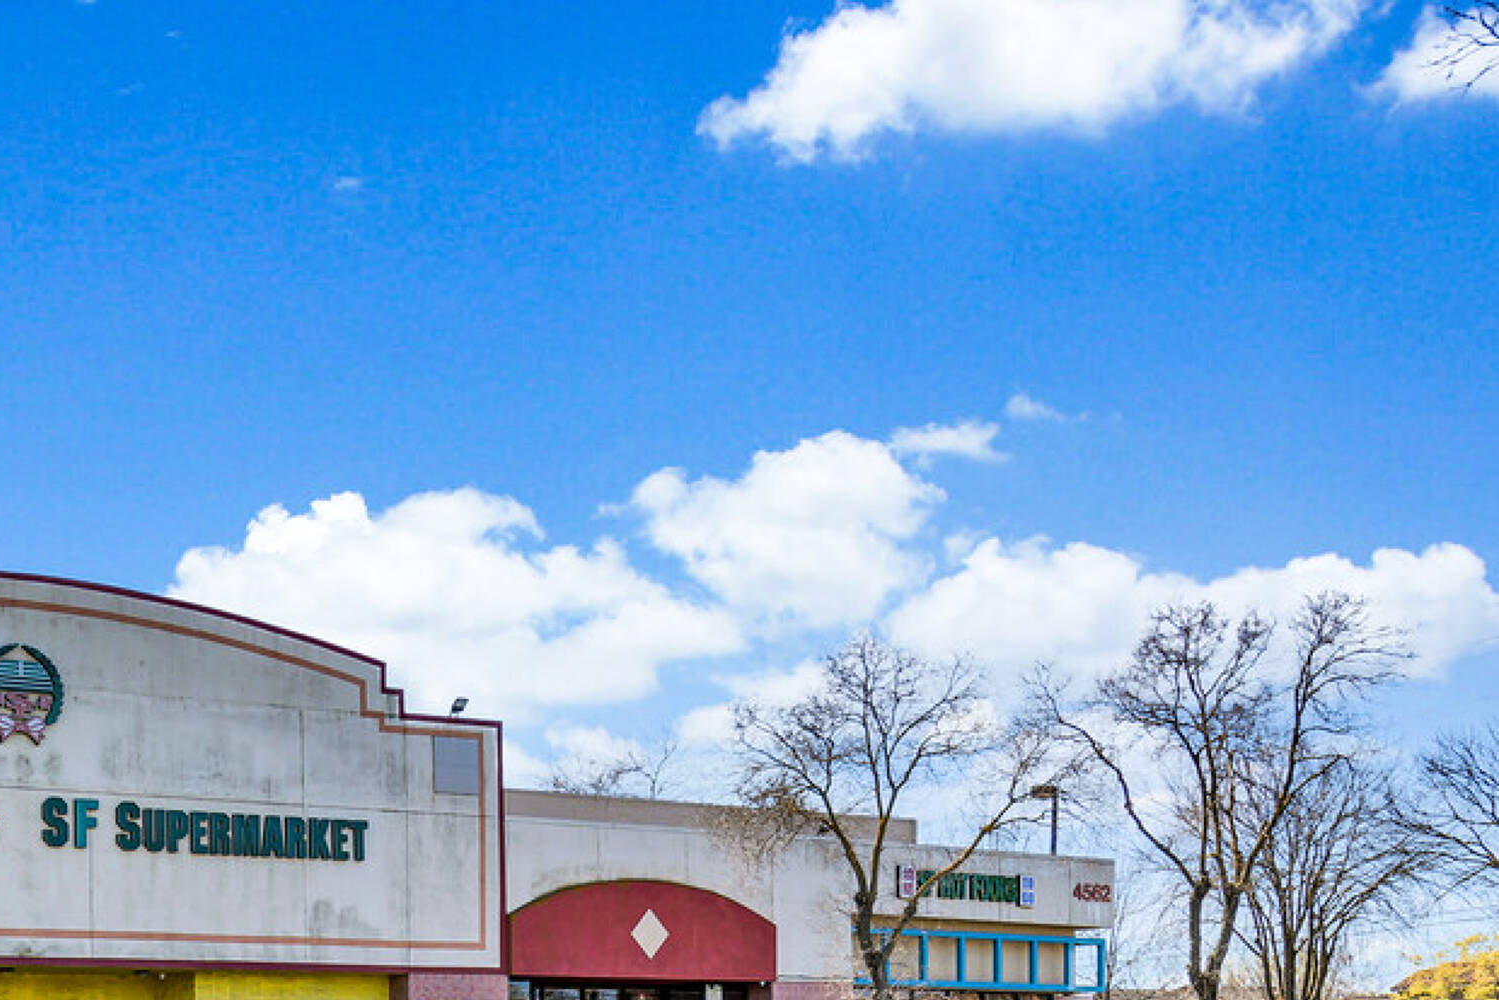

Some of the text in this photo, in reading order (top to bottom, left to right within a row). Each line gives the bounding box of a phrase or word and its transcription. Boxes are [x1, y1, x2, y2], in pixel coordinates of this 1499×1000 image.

[41, 795, 369, 862] SF SUPERMARKET
[1073, 882, 1112, 903] 4562
